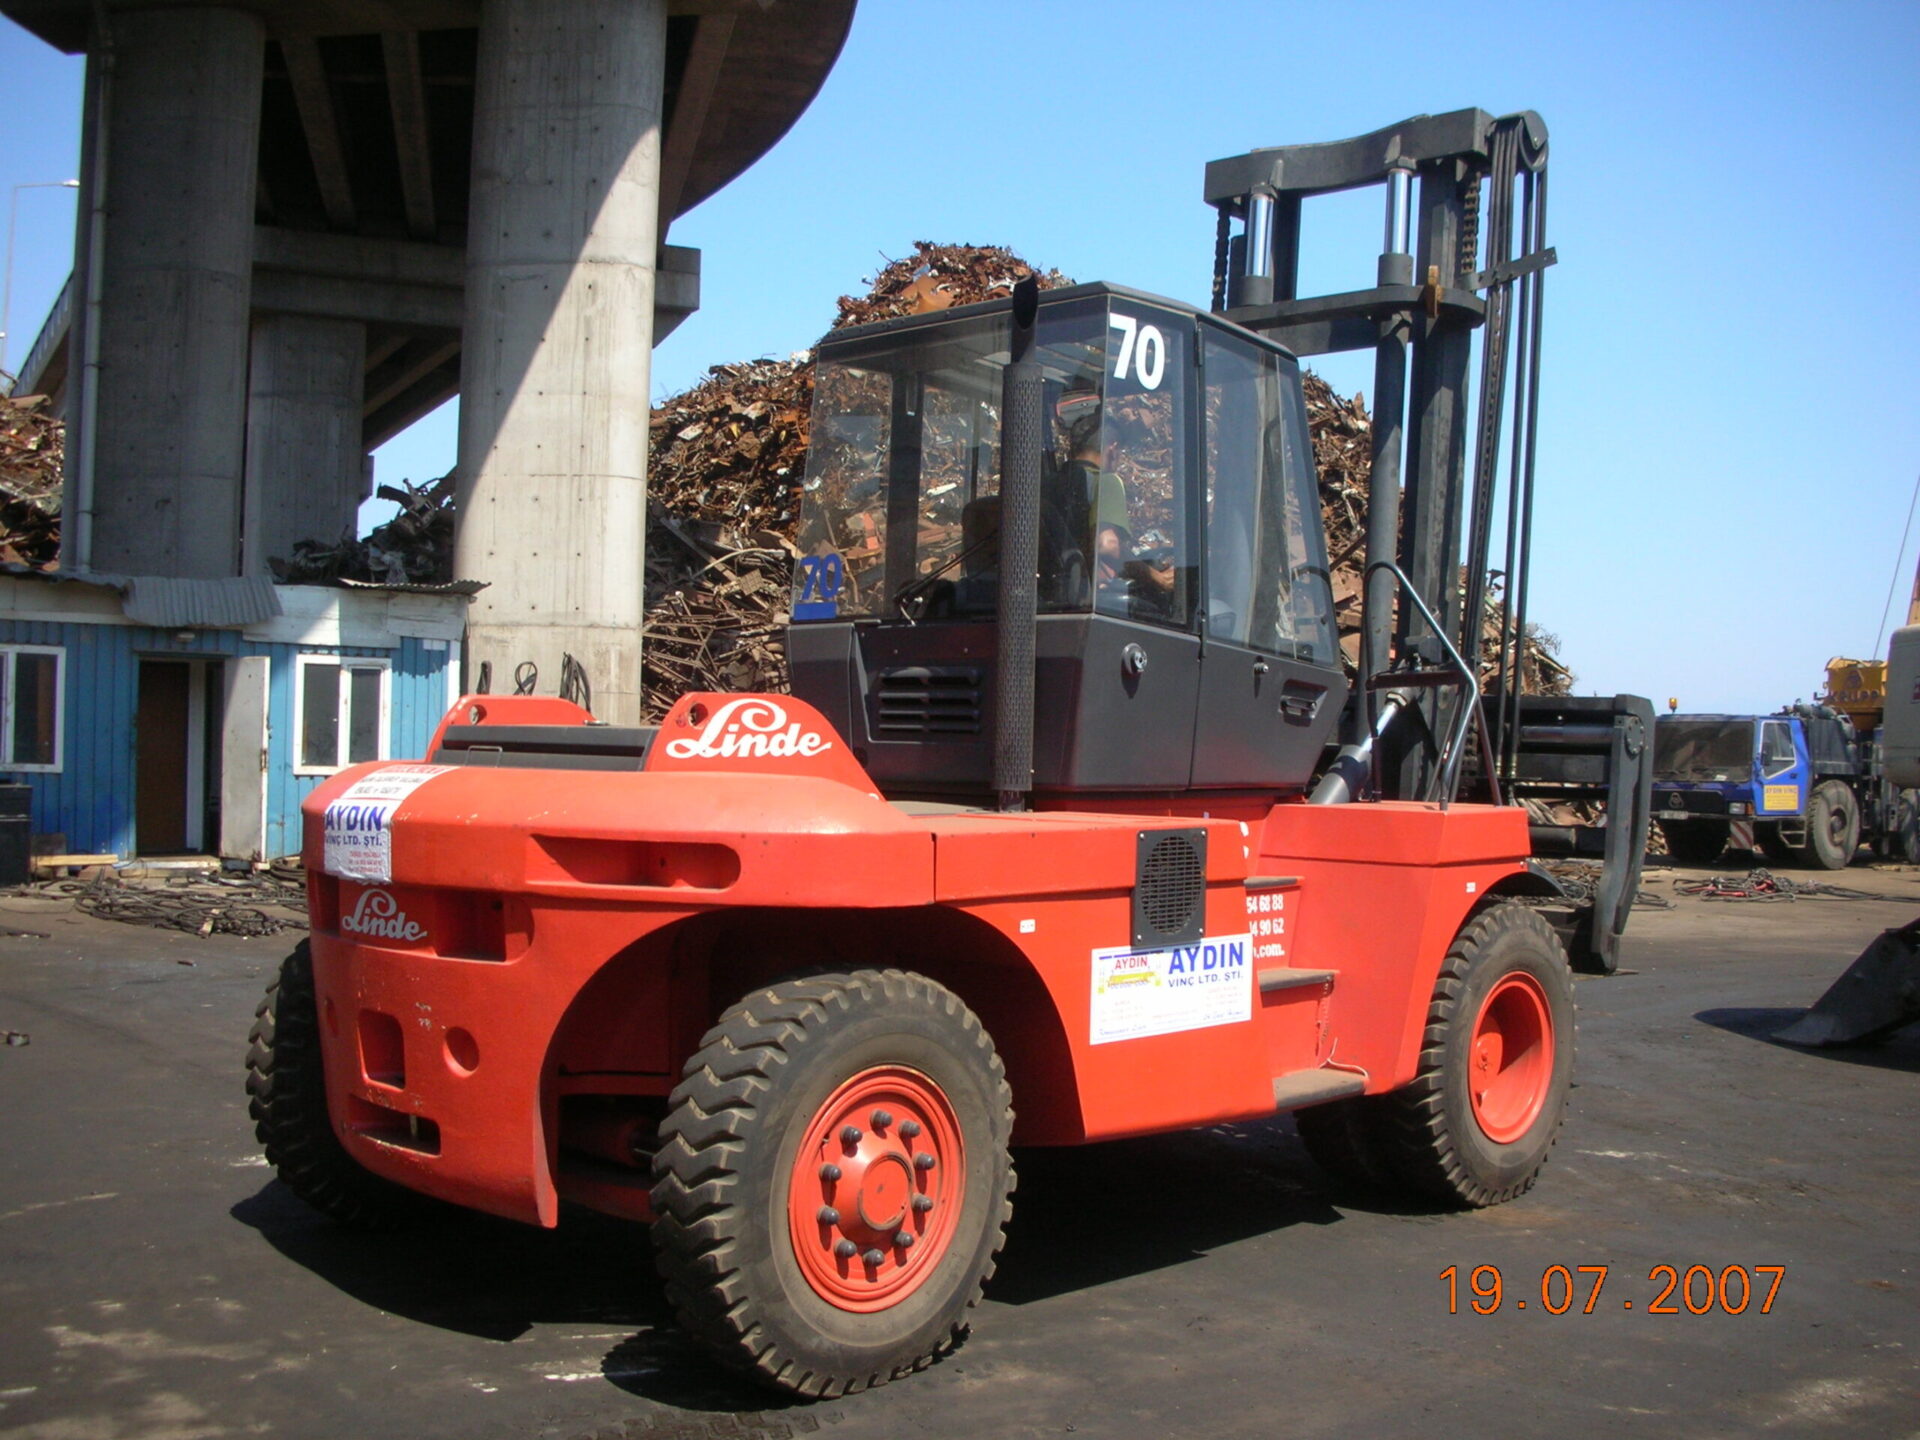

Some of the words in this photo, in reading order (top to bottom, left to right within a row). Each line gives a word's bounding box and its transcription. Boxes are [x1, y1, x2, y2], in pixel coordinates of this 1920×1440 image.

[1109, 312, 1165, 391] 70
[801, 553, 842, 601] 70
[665, 698, 832, 759] Linde
[325, 804, 387, 831] AYDIN
[342, 888, 428, 941] Linde
[1114, 956, 1149, 971] AYDIN
[1168, 941, 1244, 975] AYDIN
[1198, 973, 1221, 985] LTD.
